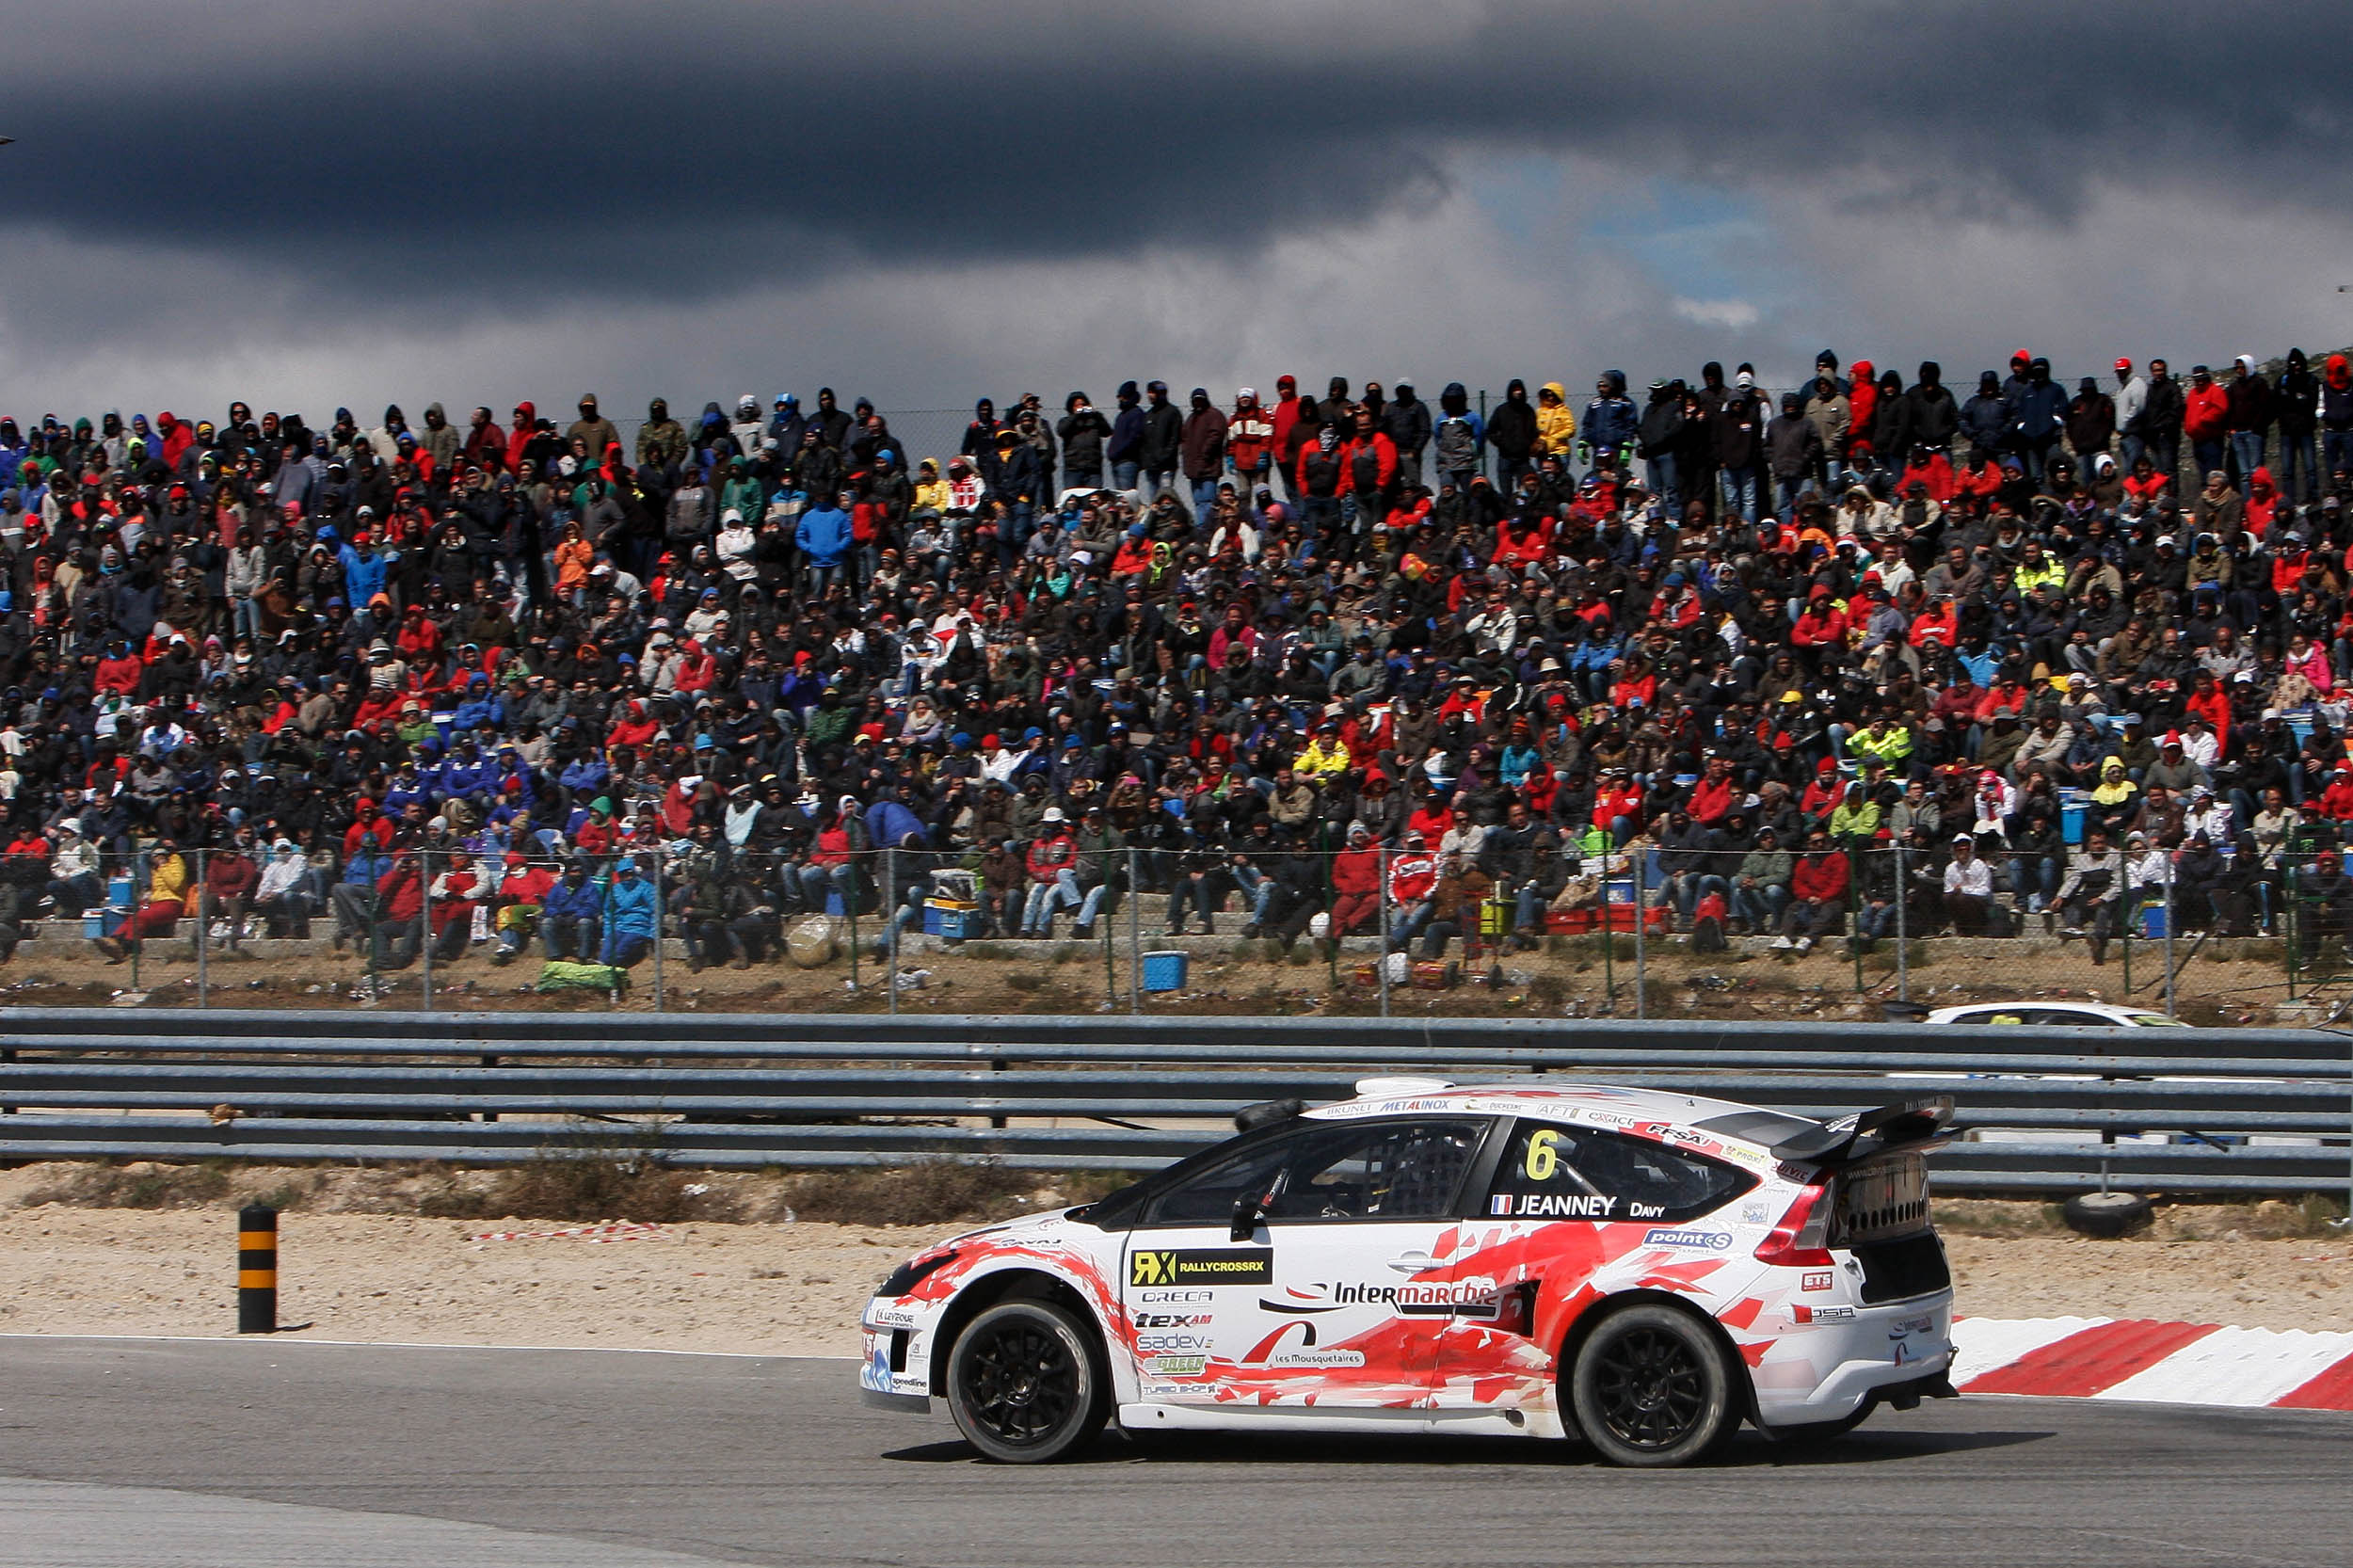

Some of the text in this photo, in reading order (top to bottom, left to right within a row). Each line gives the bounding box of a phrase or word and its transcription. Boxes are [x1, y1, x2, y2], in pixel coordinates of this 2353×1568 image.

[1380, 1099, 1451, 1112] METALINOX
[1648, 1125, 1702, 1144] FFSA
[1526, 1129, 1559, 1180] 6
[1515, 1195, 1618, 1216] JEANNEY
[1650, 1231, 1705, 1244] point
[1179, 1261, 1264, 1272] RALLYCROSSRX
[1142, 1290, 1213, 1303] ORECA
[1138, 1333, 1205, 1350] sadev
